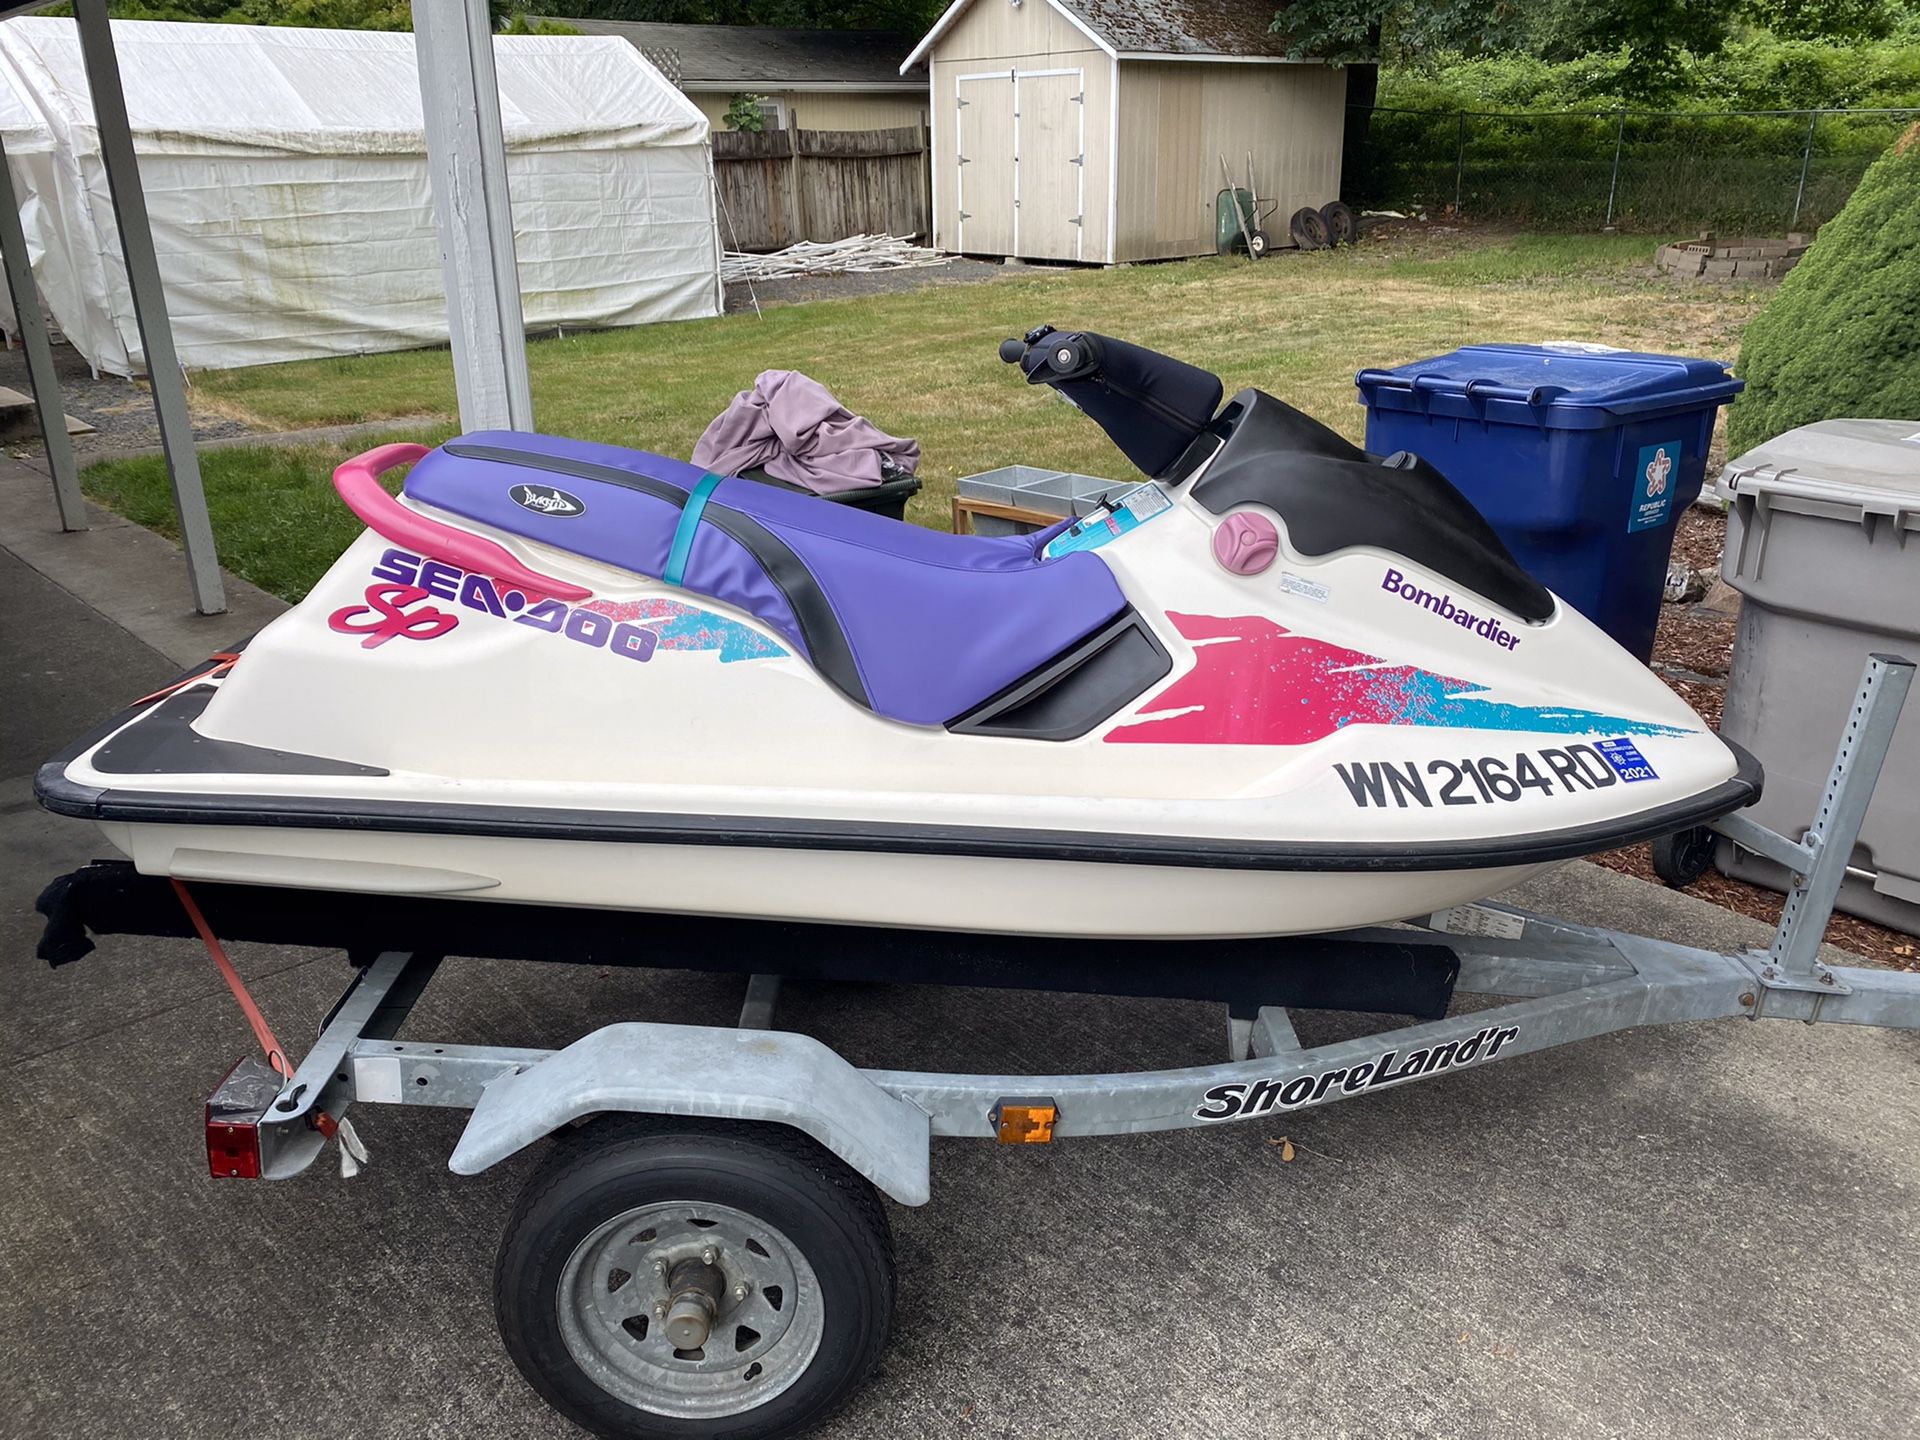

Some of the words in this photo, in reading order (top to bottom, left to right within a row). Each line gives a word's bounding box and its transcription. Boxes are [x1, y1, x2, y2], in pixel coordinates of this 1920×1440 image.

[1639, 499, 1666, 512] REPUBLIC
[1381, 568, 1521, 651] Bombardier
[1332, 761, 1434, 808] WN
[1427, 752, 1554, 806] 2164
[1537, 743, 1618, 793] RD
[1620, 765, 1655, 780] 2021
[1193, 1025, 1521, 1120] ShoreLand'r
